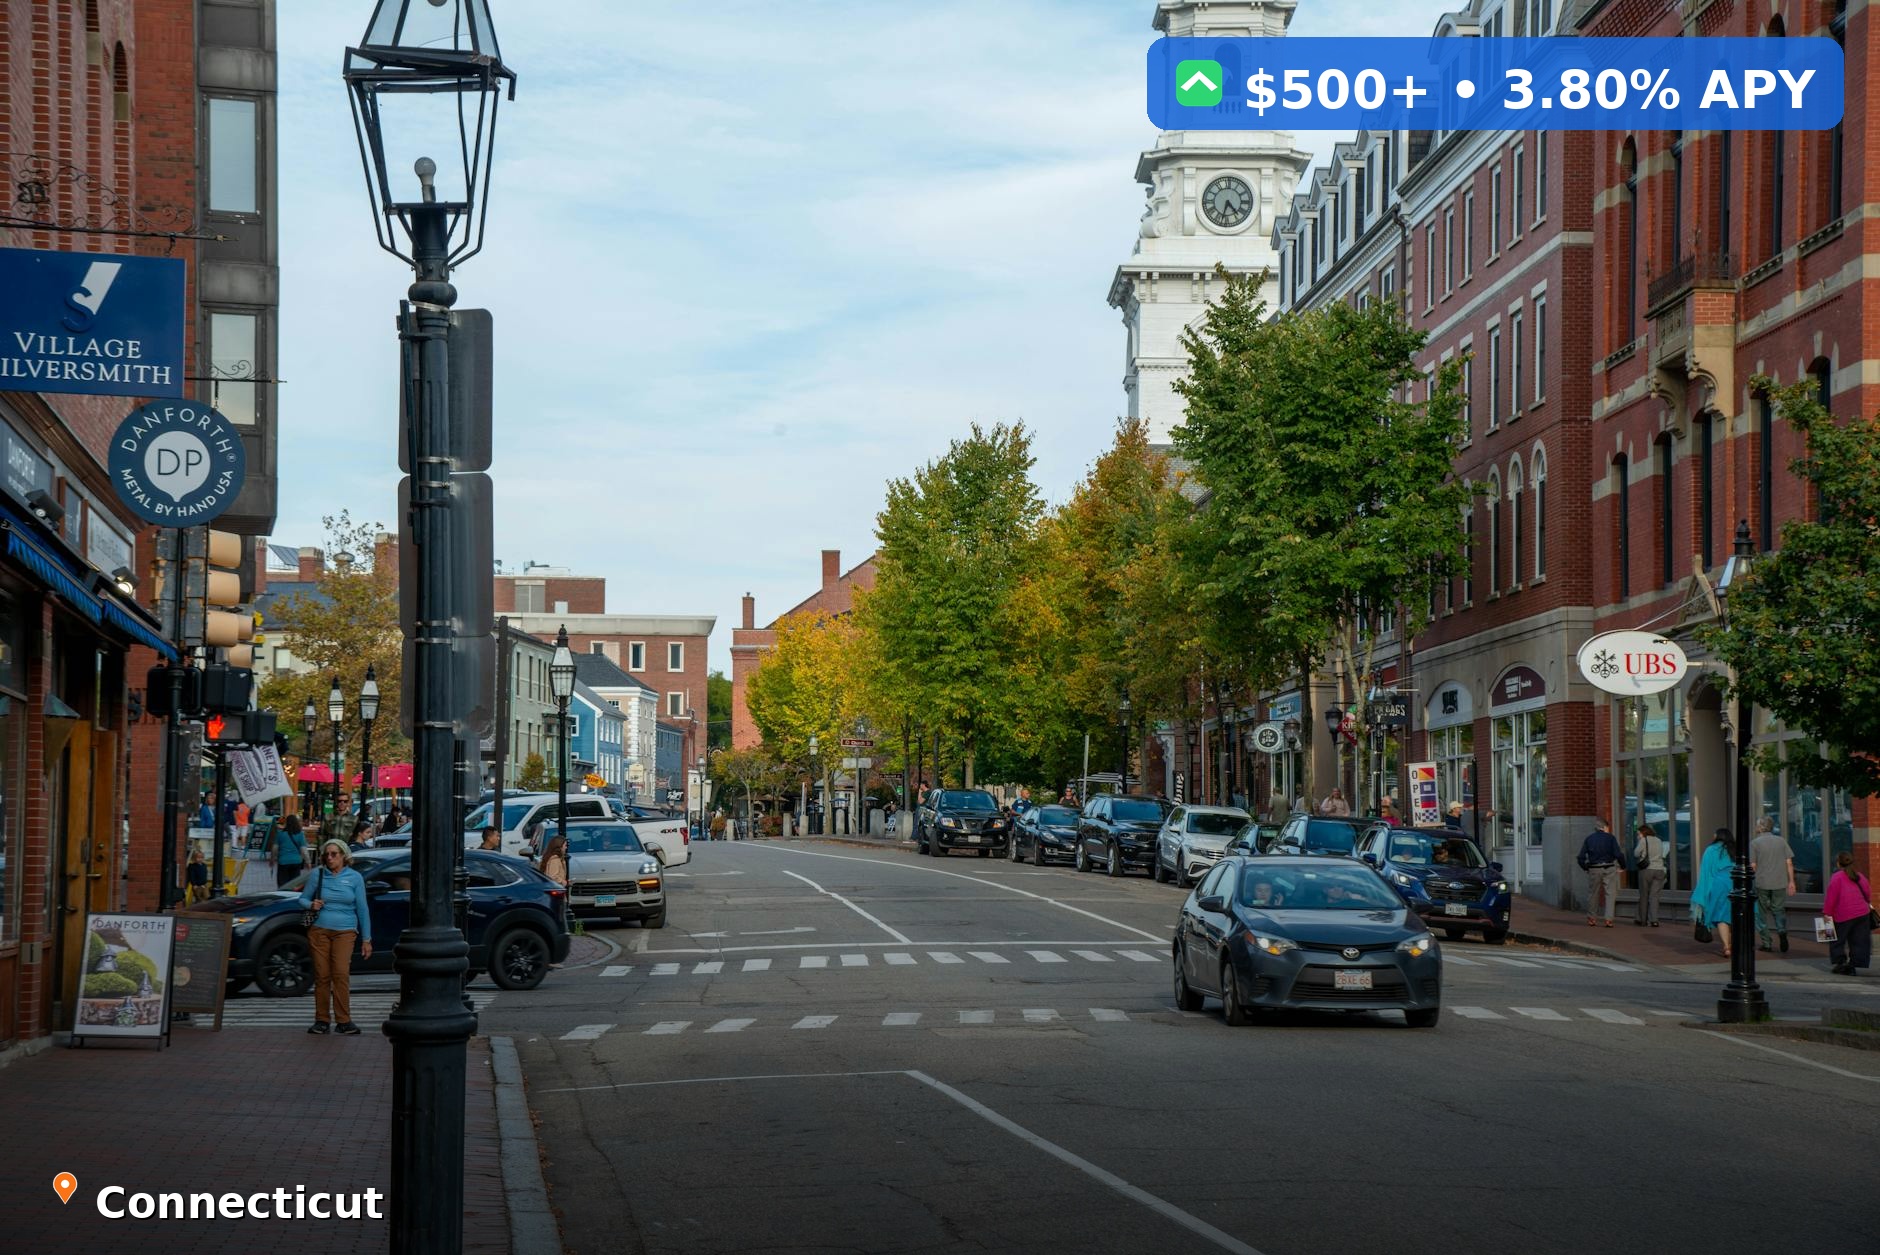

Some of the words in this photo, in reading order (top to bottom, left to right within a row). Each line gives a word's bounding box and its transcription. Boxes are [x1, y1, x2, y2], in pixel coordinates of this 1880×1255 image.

[13, 332, 142, 359] VILLAGE
[0, 357, 172, 385] ILVERSMITH
[157, 448, 203, 477] DP
[121, 468, 152, 509] METAL
[155, 503, 173, 516] BY
[177, 495, 217, 517] HAND
[214, 470, 234, 495] USA
[1624, 653, 1677, 675] UBS
[1411, 770, 1422, 821] OPEN
[96, 920, 166, 930] DANFORTH
